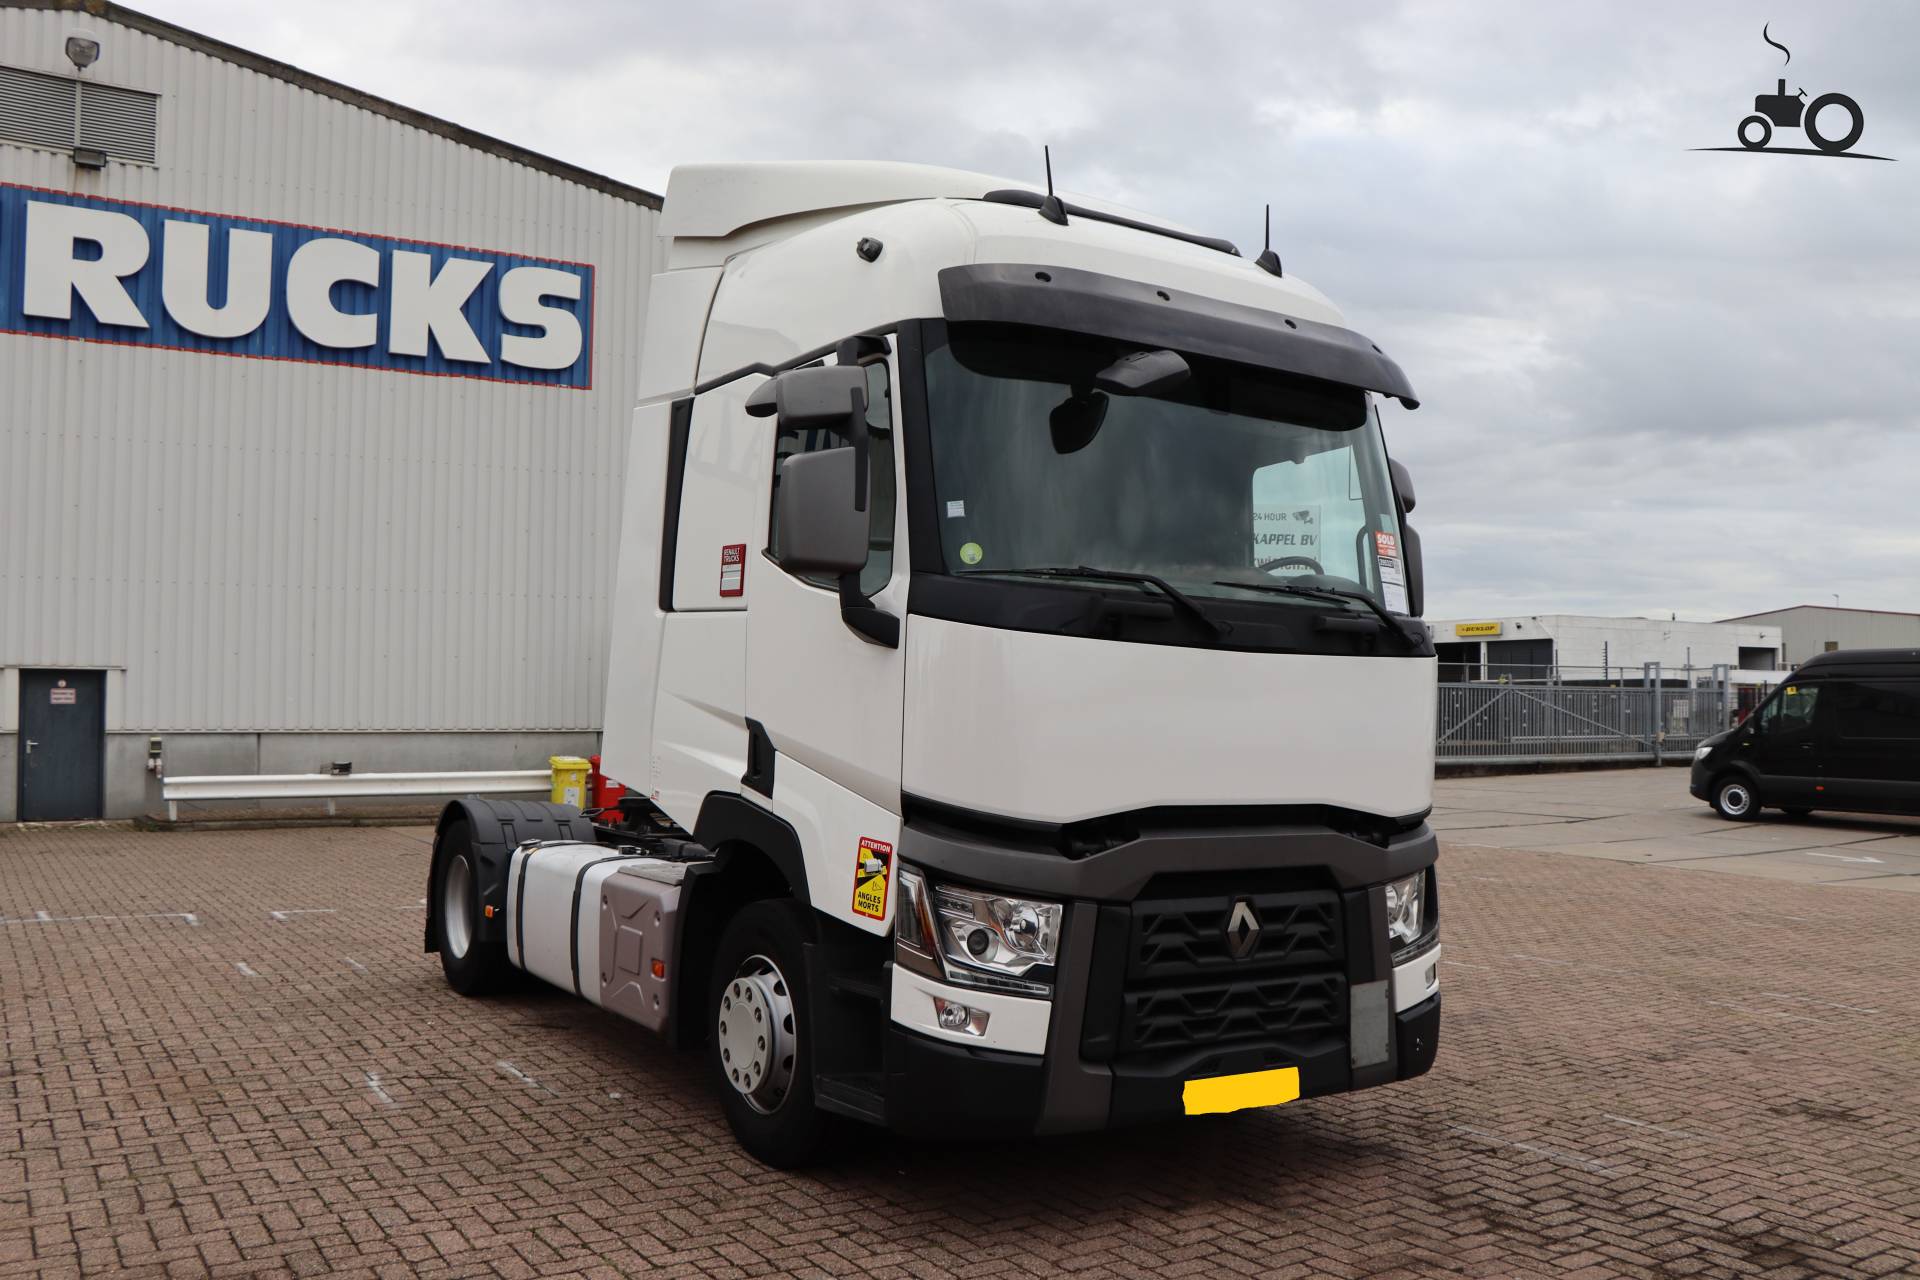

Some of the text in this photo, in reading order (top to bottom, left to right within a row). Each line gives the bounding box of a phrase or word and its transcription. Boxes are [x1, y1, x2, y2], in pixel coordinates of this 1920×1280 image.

[23, 200, 582, 371] RUCKS
[1264, 512, 1287, 521] HOUR
[1300, 534, 1319, 546] BV
[1377, 534, 1395, 545] SOLD
[860, 839, 891, 853] ATTENTION
[857, 891, 881, 904] ANGLES
[857, 899, 880, 912] MORTS
